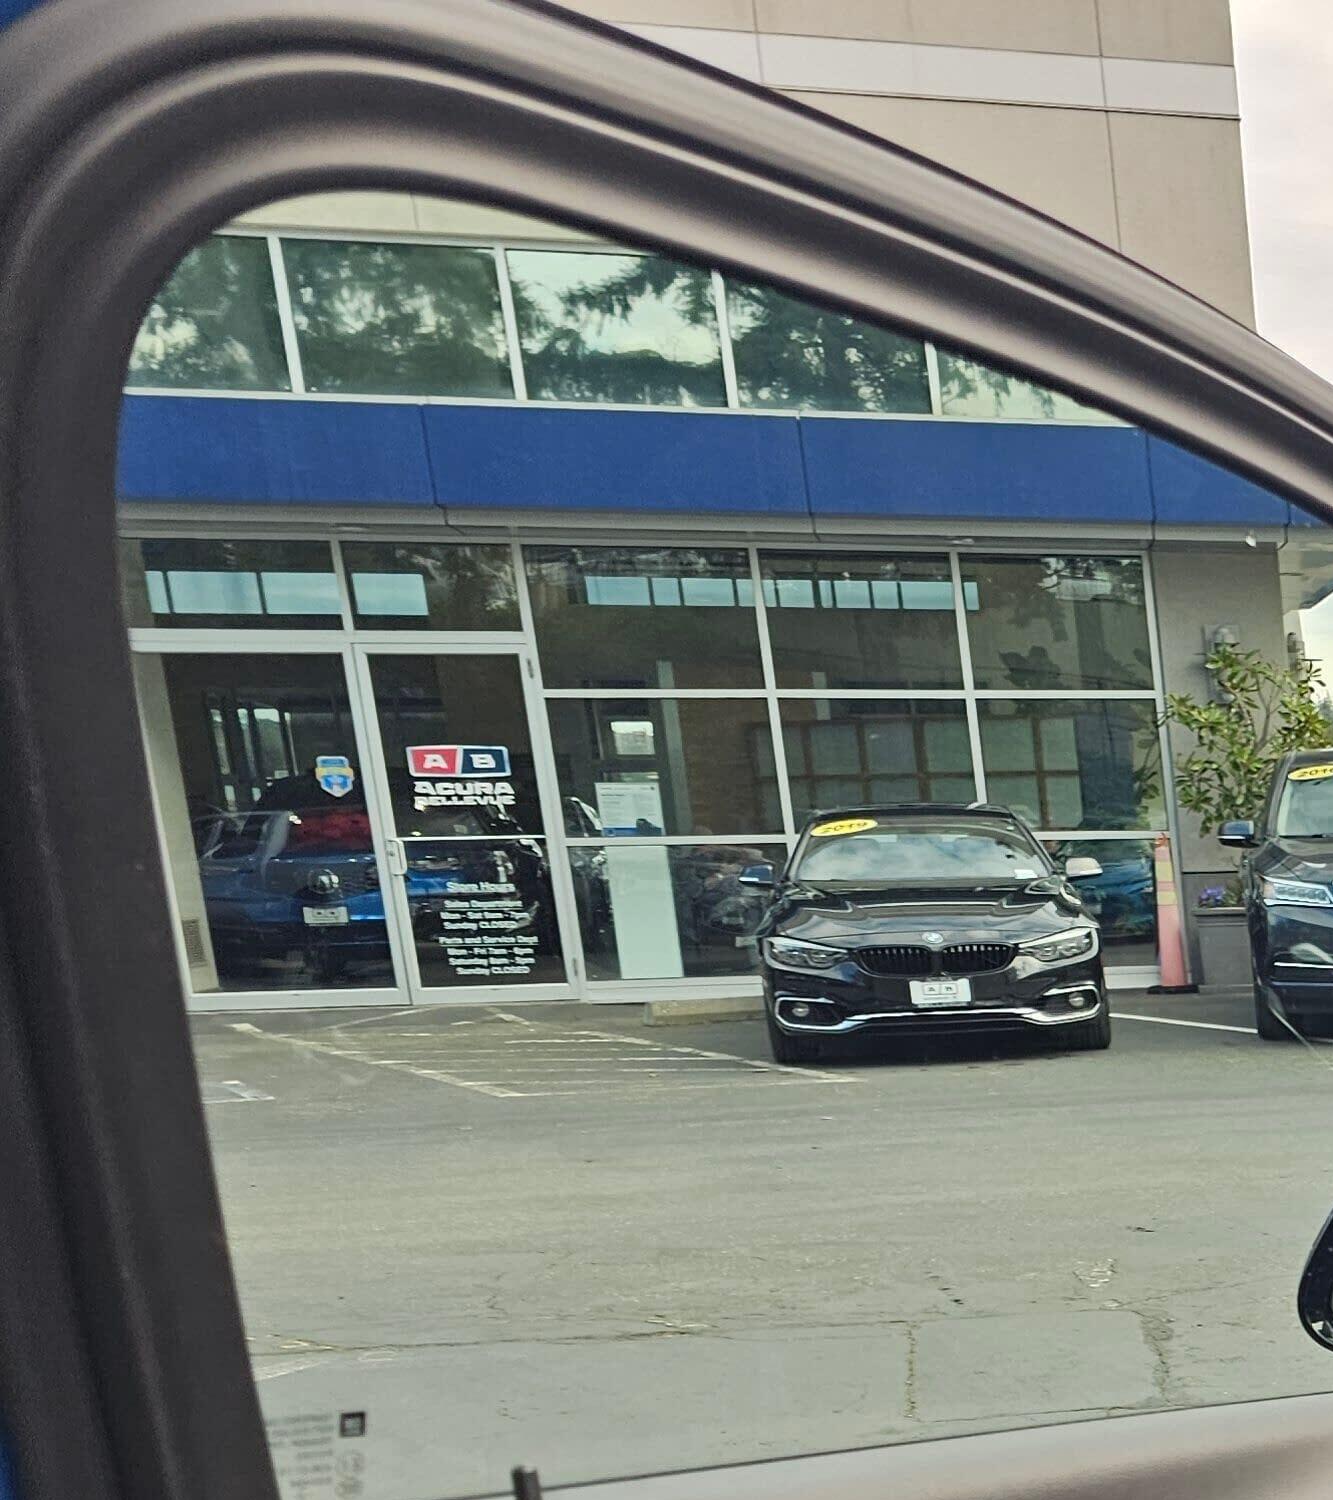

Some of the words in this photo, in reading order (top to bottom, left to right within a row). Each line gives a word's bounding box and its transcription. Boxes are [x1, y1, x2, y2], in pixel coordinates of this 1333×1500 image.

[423, 754, 448, 769] A
[469, 753, 496, 769] B
[413, 781, 515, 796] ACURA
[414, 795, 516, 807] BELLEVUE
